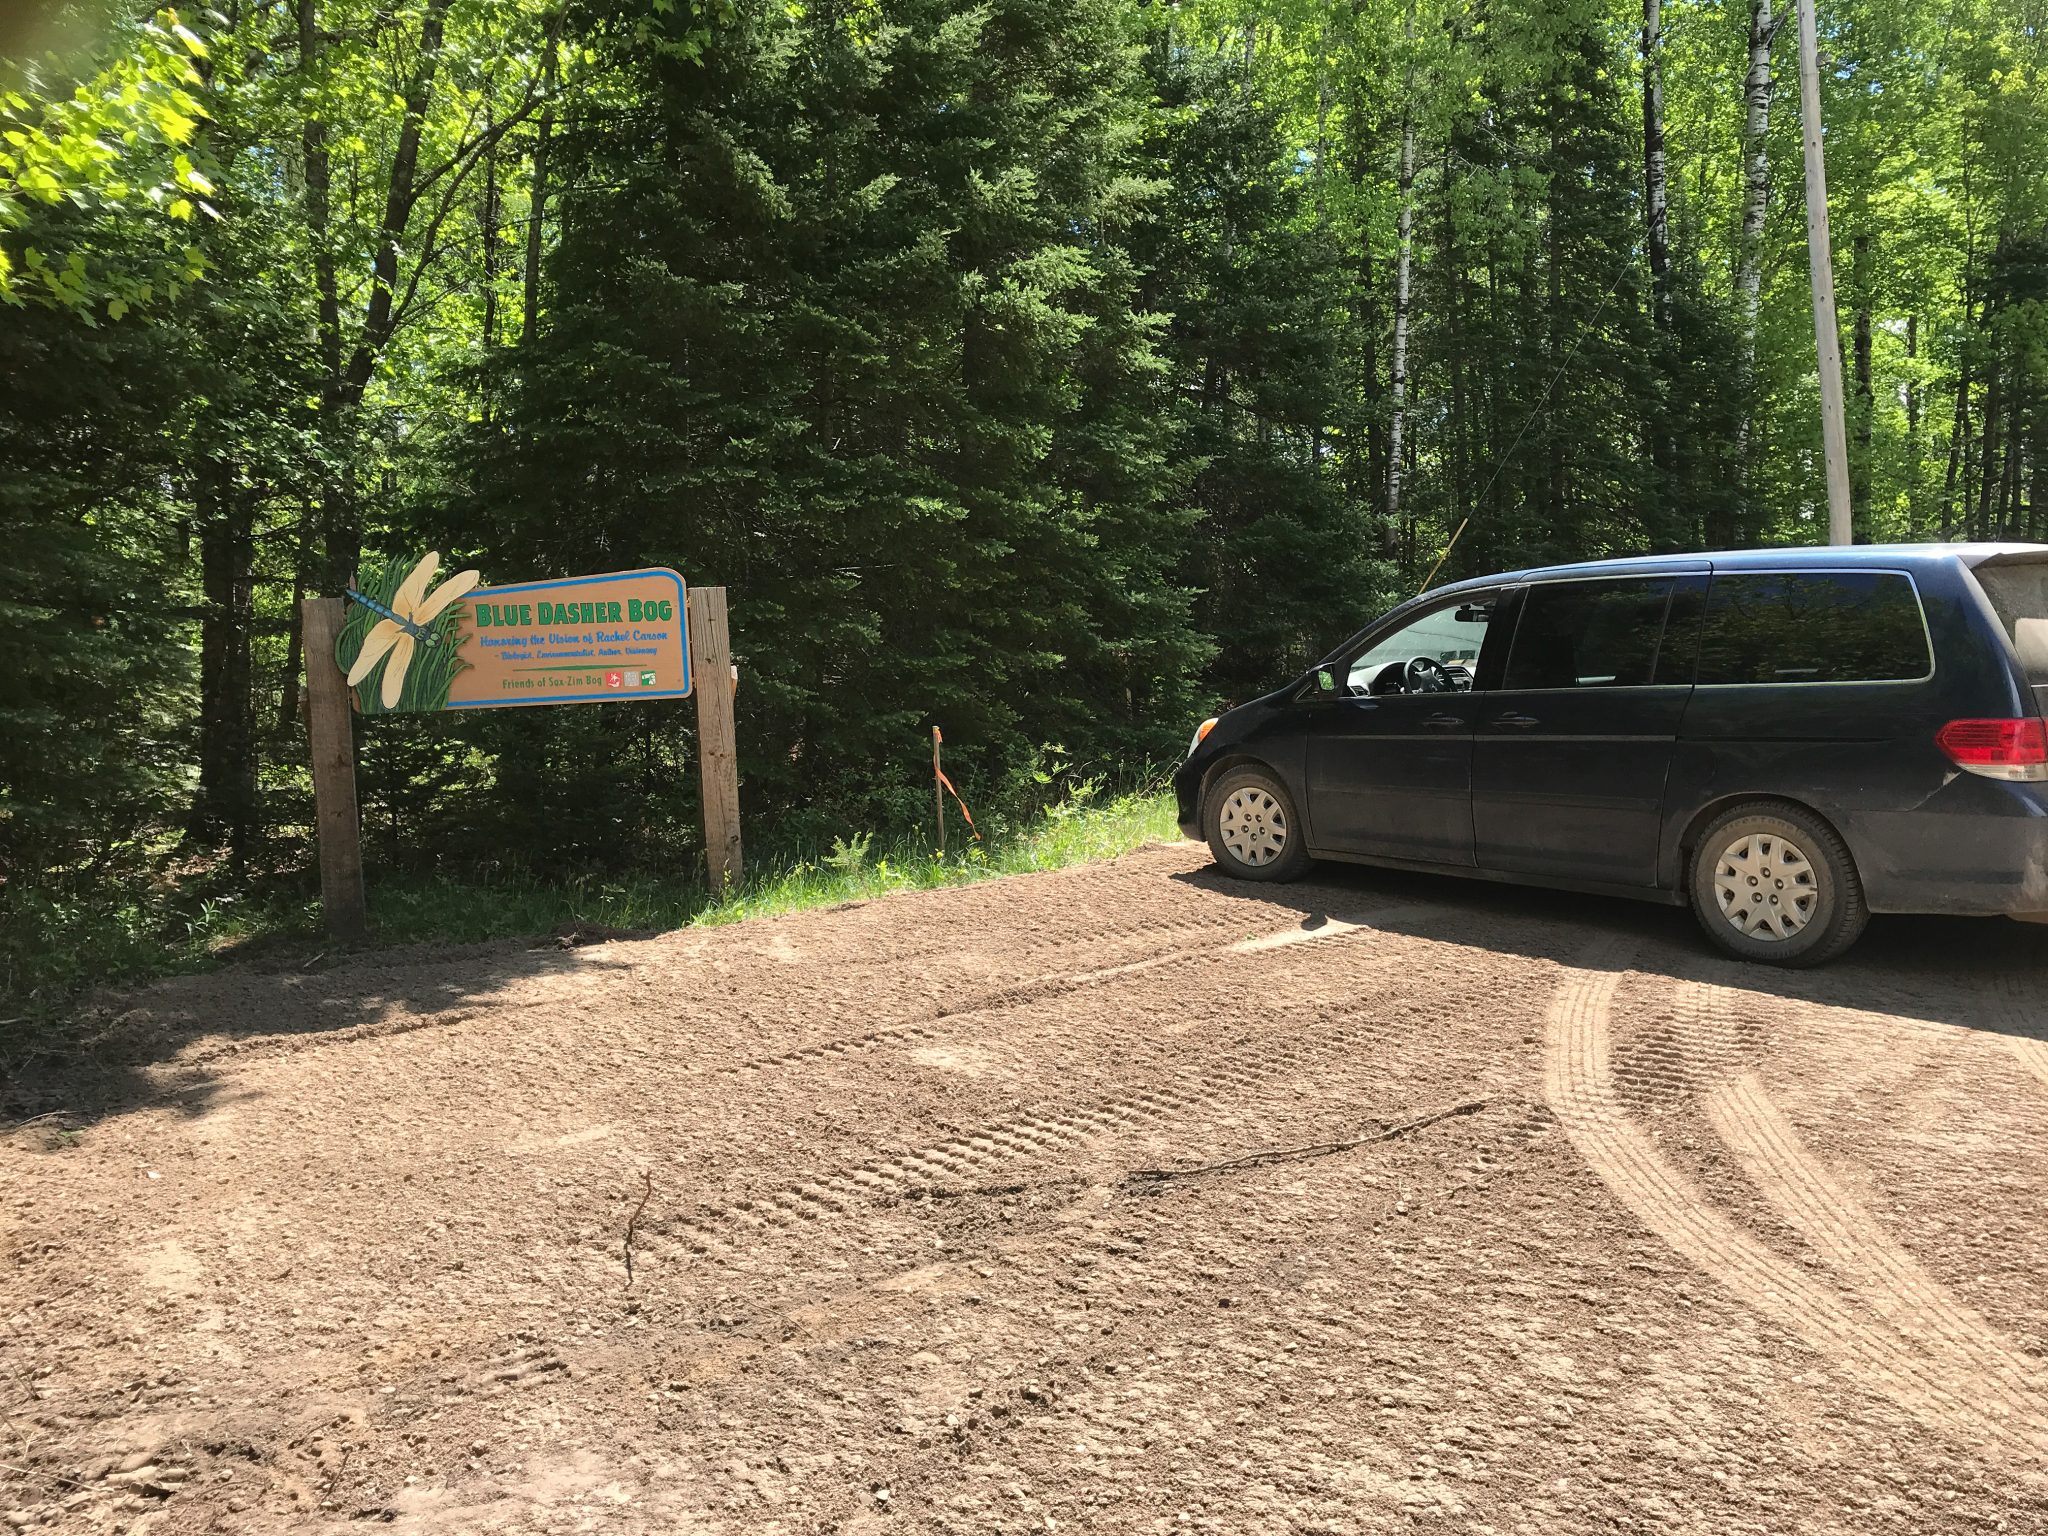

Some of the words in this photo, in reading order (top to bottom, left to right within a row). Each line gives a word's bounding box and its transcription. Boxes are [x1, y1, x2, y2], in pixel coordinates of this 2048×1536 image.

[475, 603, 532, 628] BLUE
[537, 601, 623, 626] DASHER
[627, 599, 672, 622] BOG
[480, 636, 528, 648] Honoring
[530, 634, 545, 645] the
[549, 633, 580, 644] Vision
[582, 633, 593, 645] of
[596, 630, 630, 643] Rachel
[633, 630, 667, 641] Carson
[502, 678, 534, 689] Friends
[537, 677, 546, 688] of
[586, 675, 602, 687] Bog
